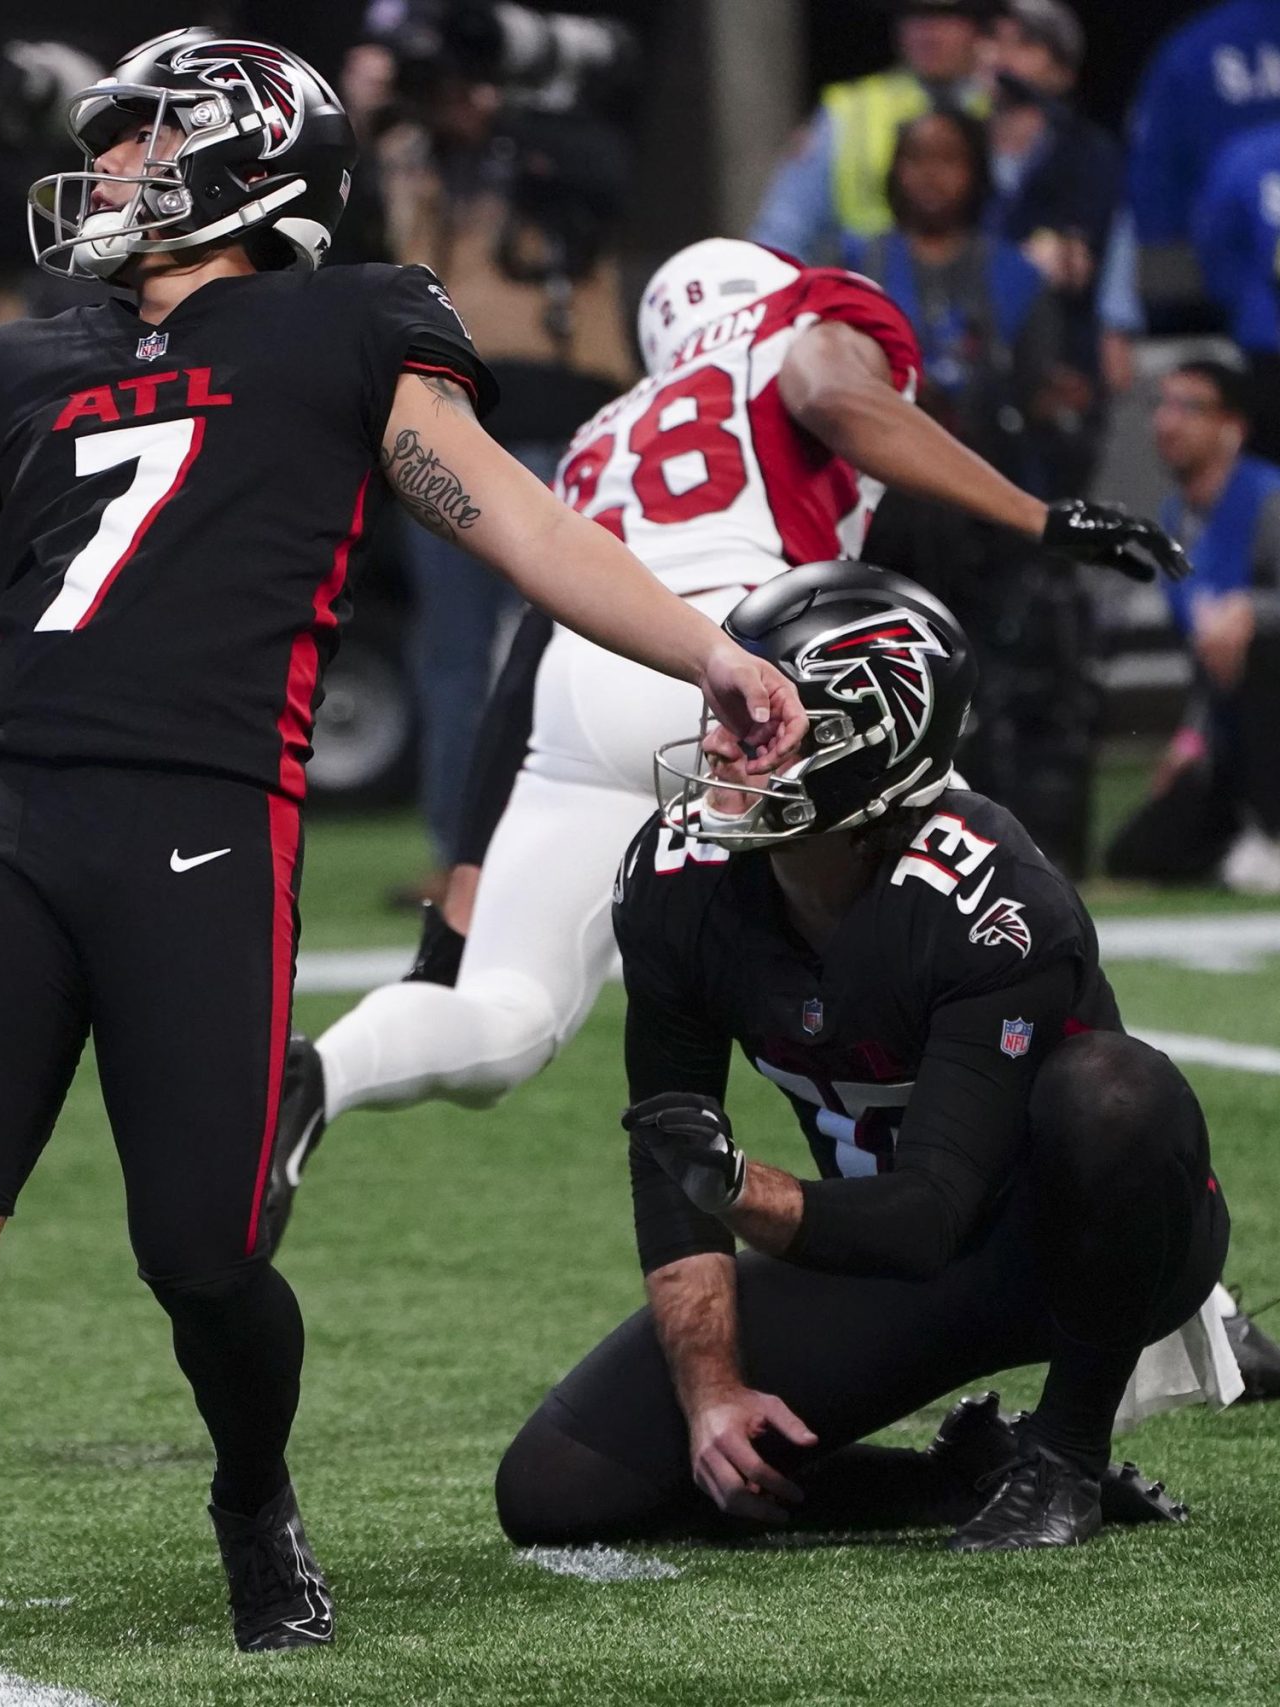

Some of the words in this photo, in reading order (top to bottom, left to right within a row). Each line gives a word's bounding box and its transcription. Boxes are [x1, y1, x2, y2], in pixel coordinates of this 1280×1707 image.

[51, 367, 233, 432] ATL
[33, 416, 207, 632] 7
[890, 810, 1000, 897] 13
